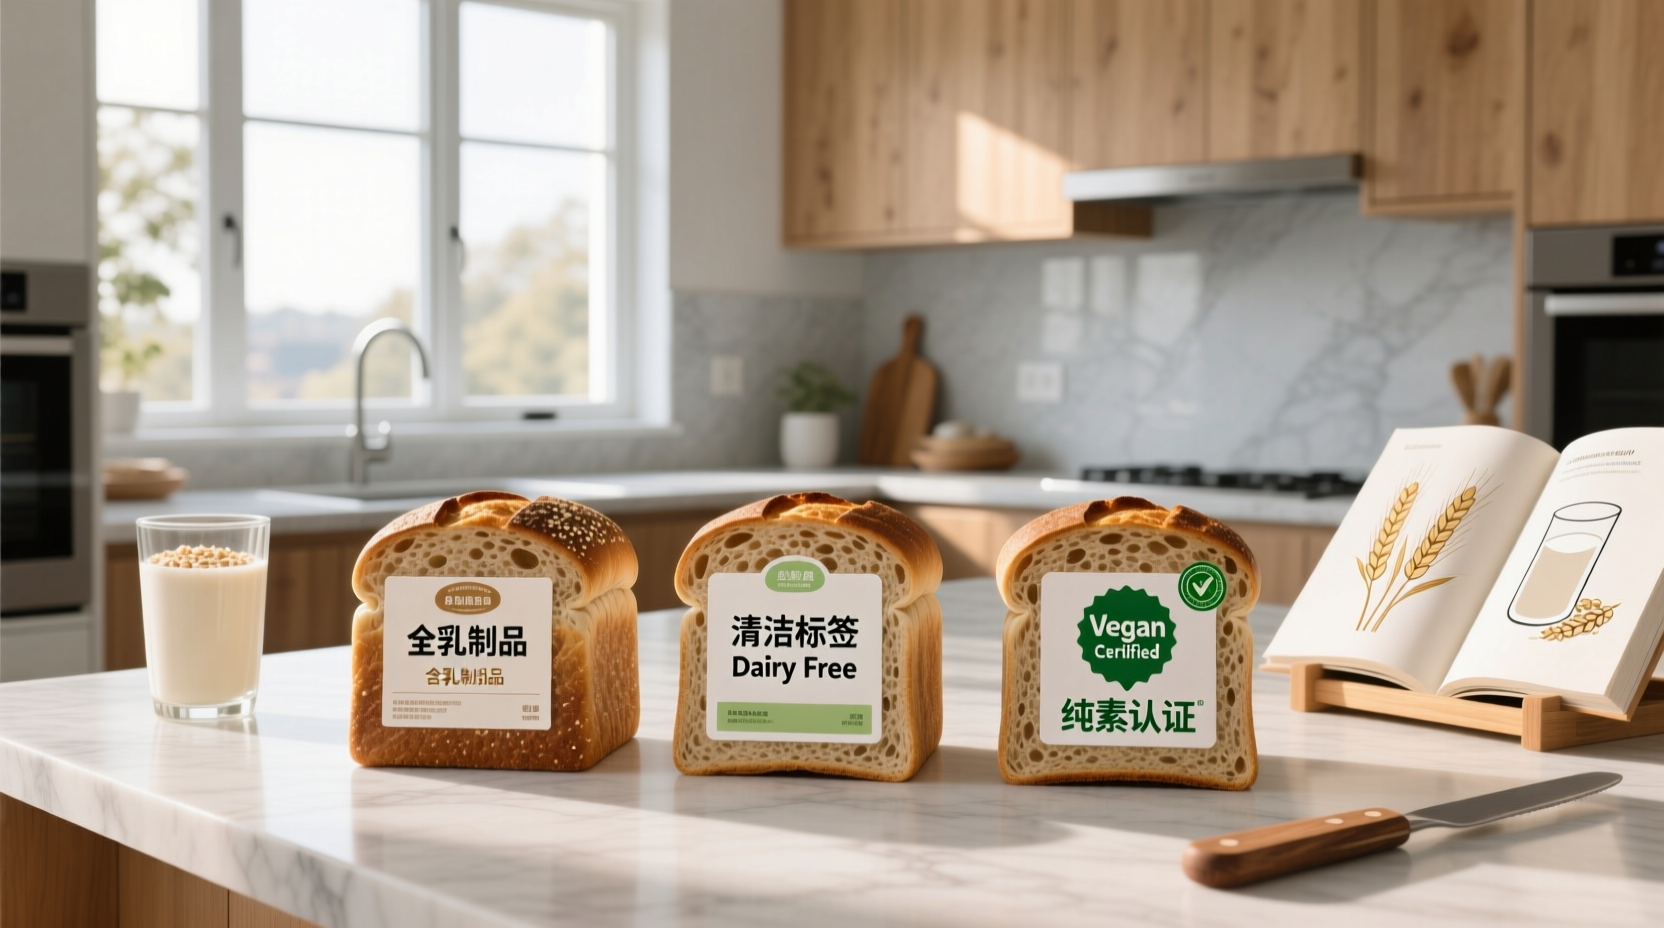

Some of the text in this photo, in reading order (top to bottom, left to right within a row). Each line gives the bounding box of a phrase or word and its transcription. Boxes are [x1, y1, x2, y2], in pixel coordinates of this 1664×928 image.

[407, 624, 527, 657] 全乳制品
[731, 613, 859, 649] 清洁标签
[1089, 613, 1166, 644] Vegan
[732, 655, 857, 685] Dairy Free
[1061, 697, 1197, 734] 纯素认证
